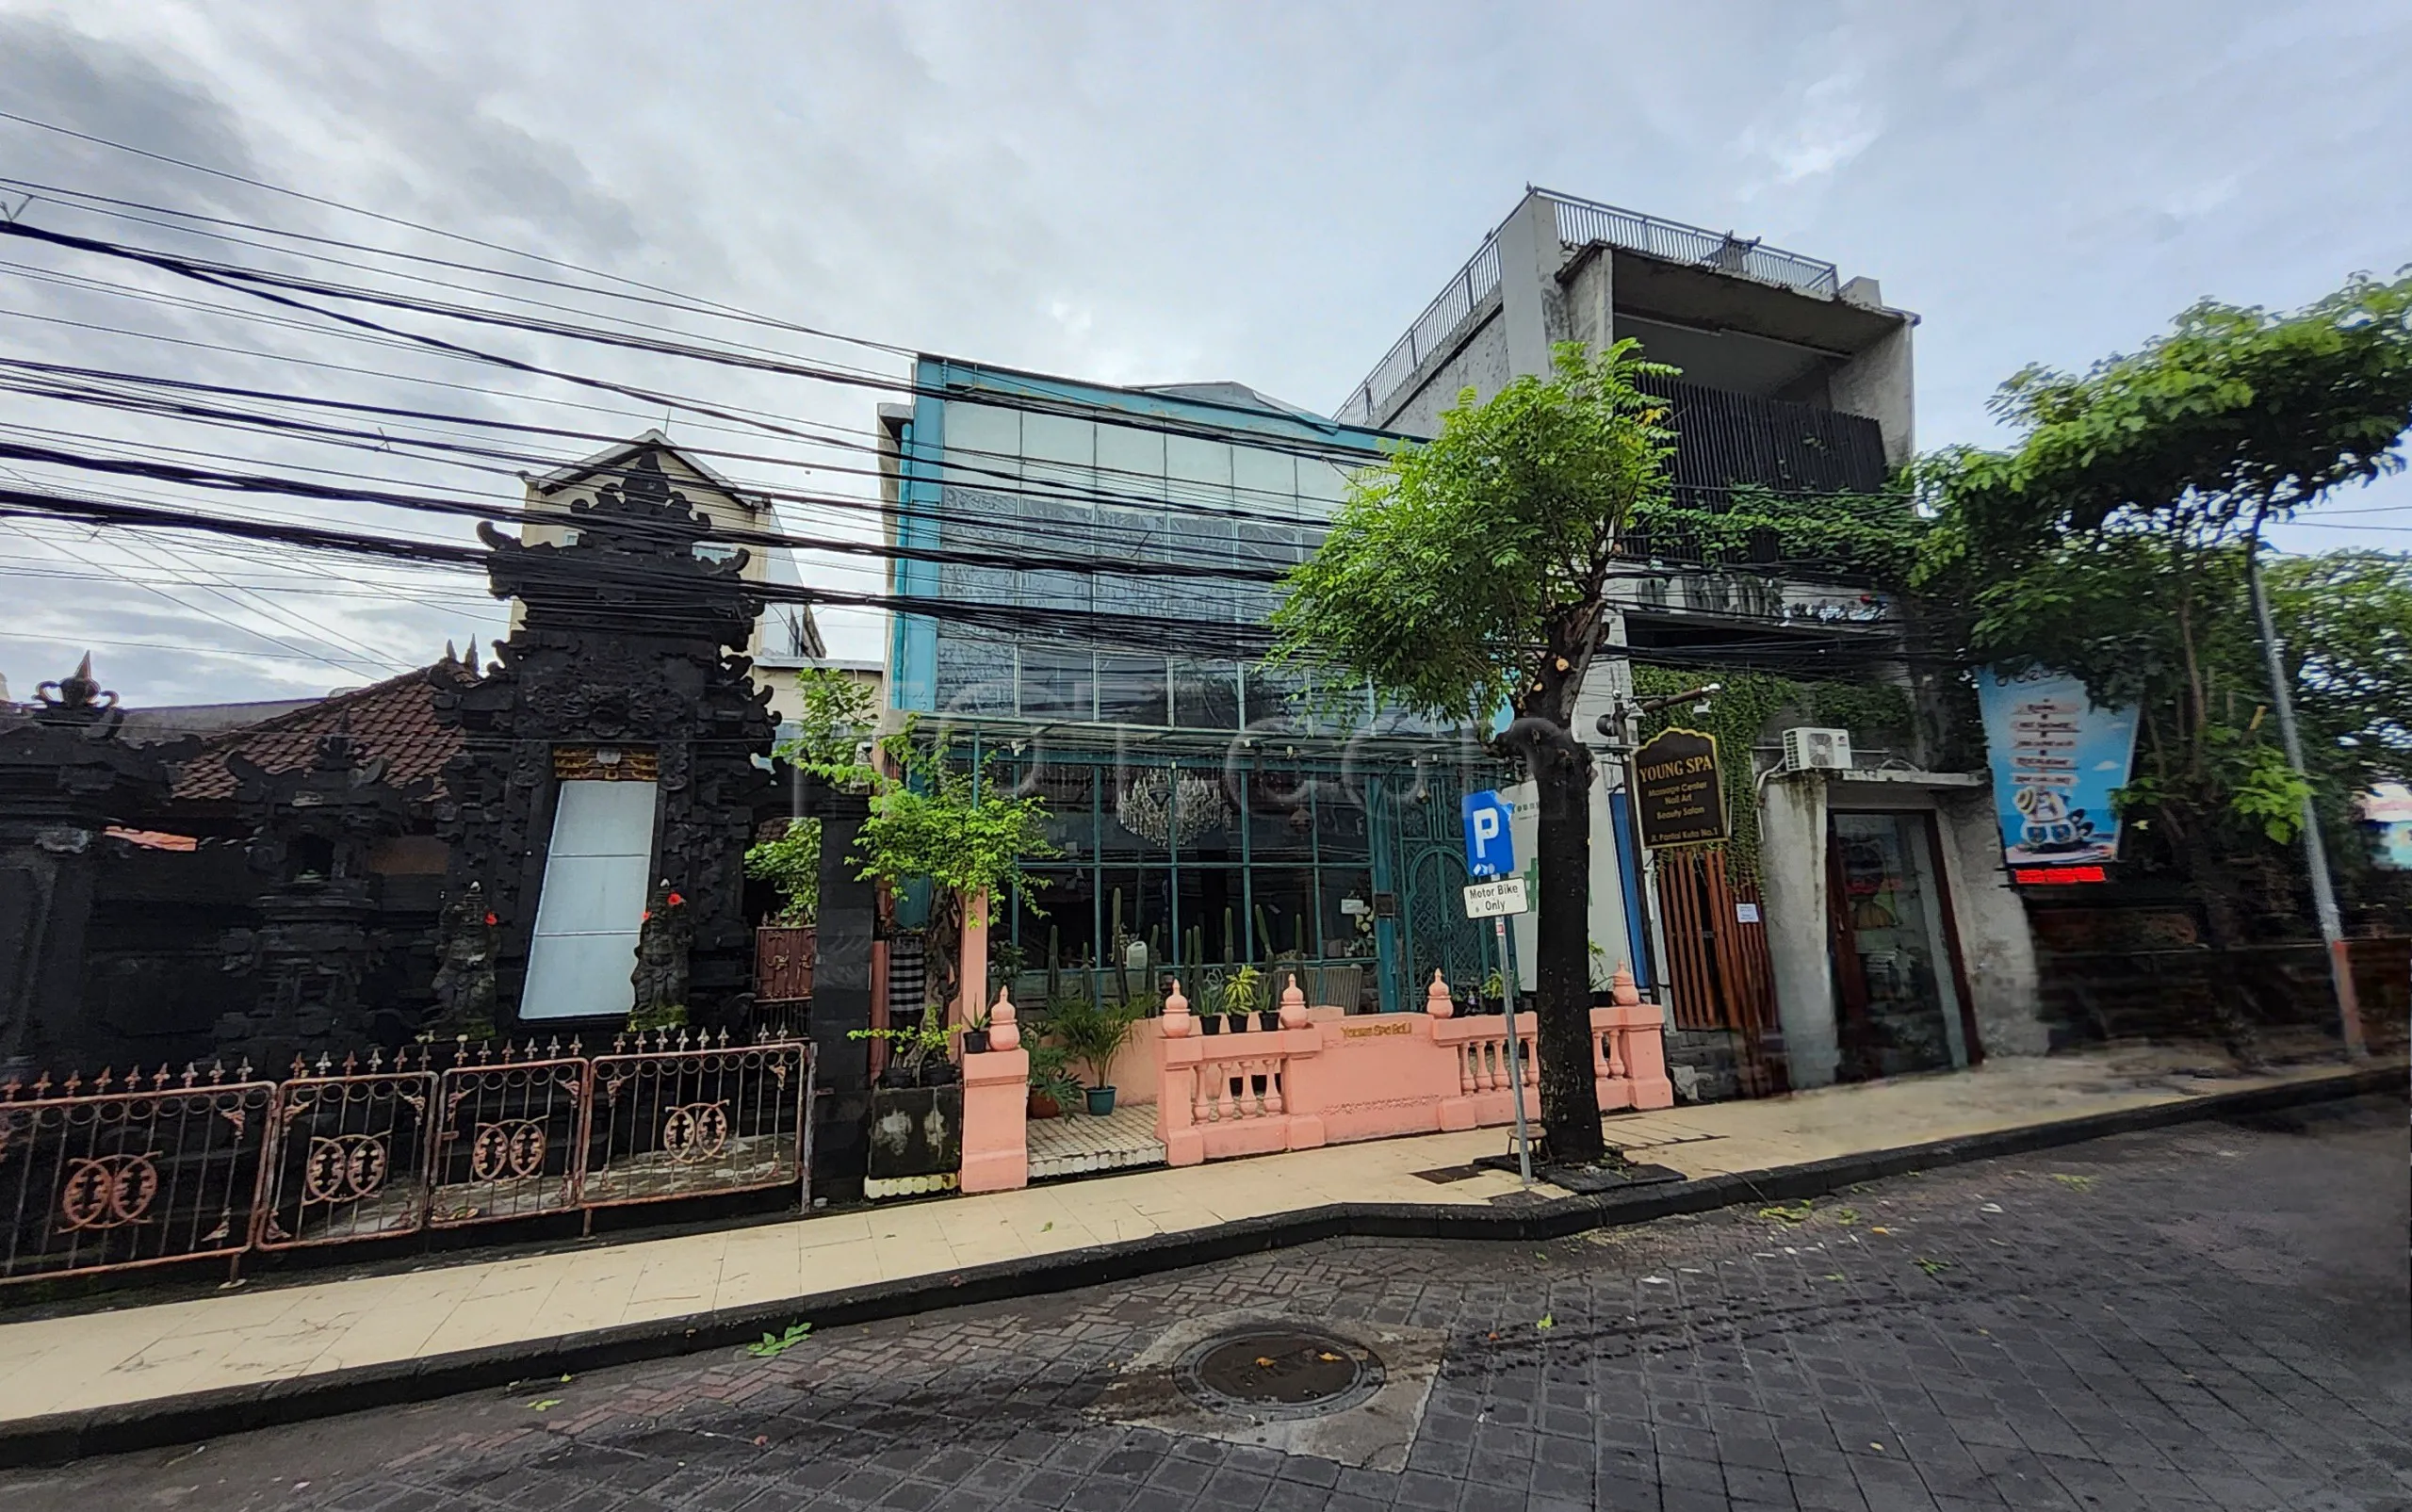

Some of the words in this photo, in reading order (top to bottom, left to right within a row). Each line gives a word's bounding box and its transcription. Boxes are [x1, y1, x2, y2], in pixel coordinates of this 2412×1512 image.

[1639, 760, 1684, 783] YOUNG
[1686, 755, 1713, 773] SPA
[1649, 786, 1680, 797] Massage
[1681, 782, 1707, 791] Center
[1664, 795, 1679, 805] Nail
[1681, 793, 1692, 802] Art
[1656, 809, 1682, 820] Beauty
[1683, 806, 1704, 816] Salon
[1473, 807, 1499, 859] P
[1470, 888, 1494, 900] Motor
[1496, 884, 1519, 895] Bike
[1485, 899, 1506, 912] Only
